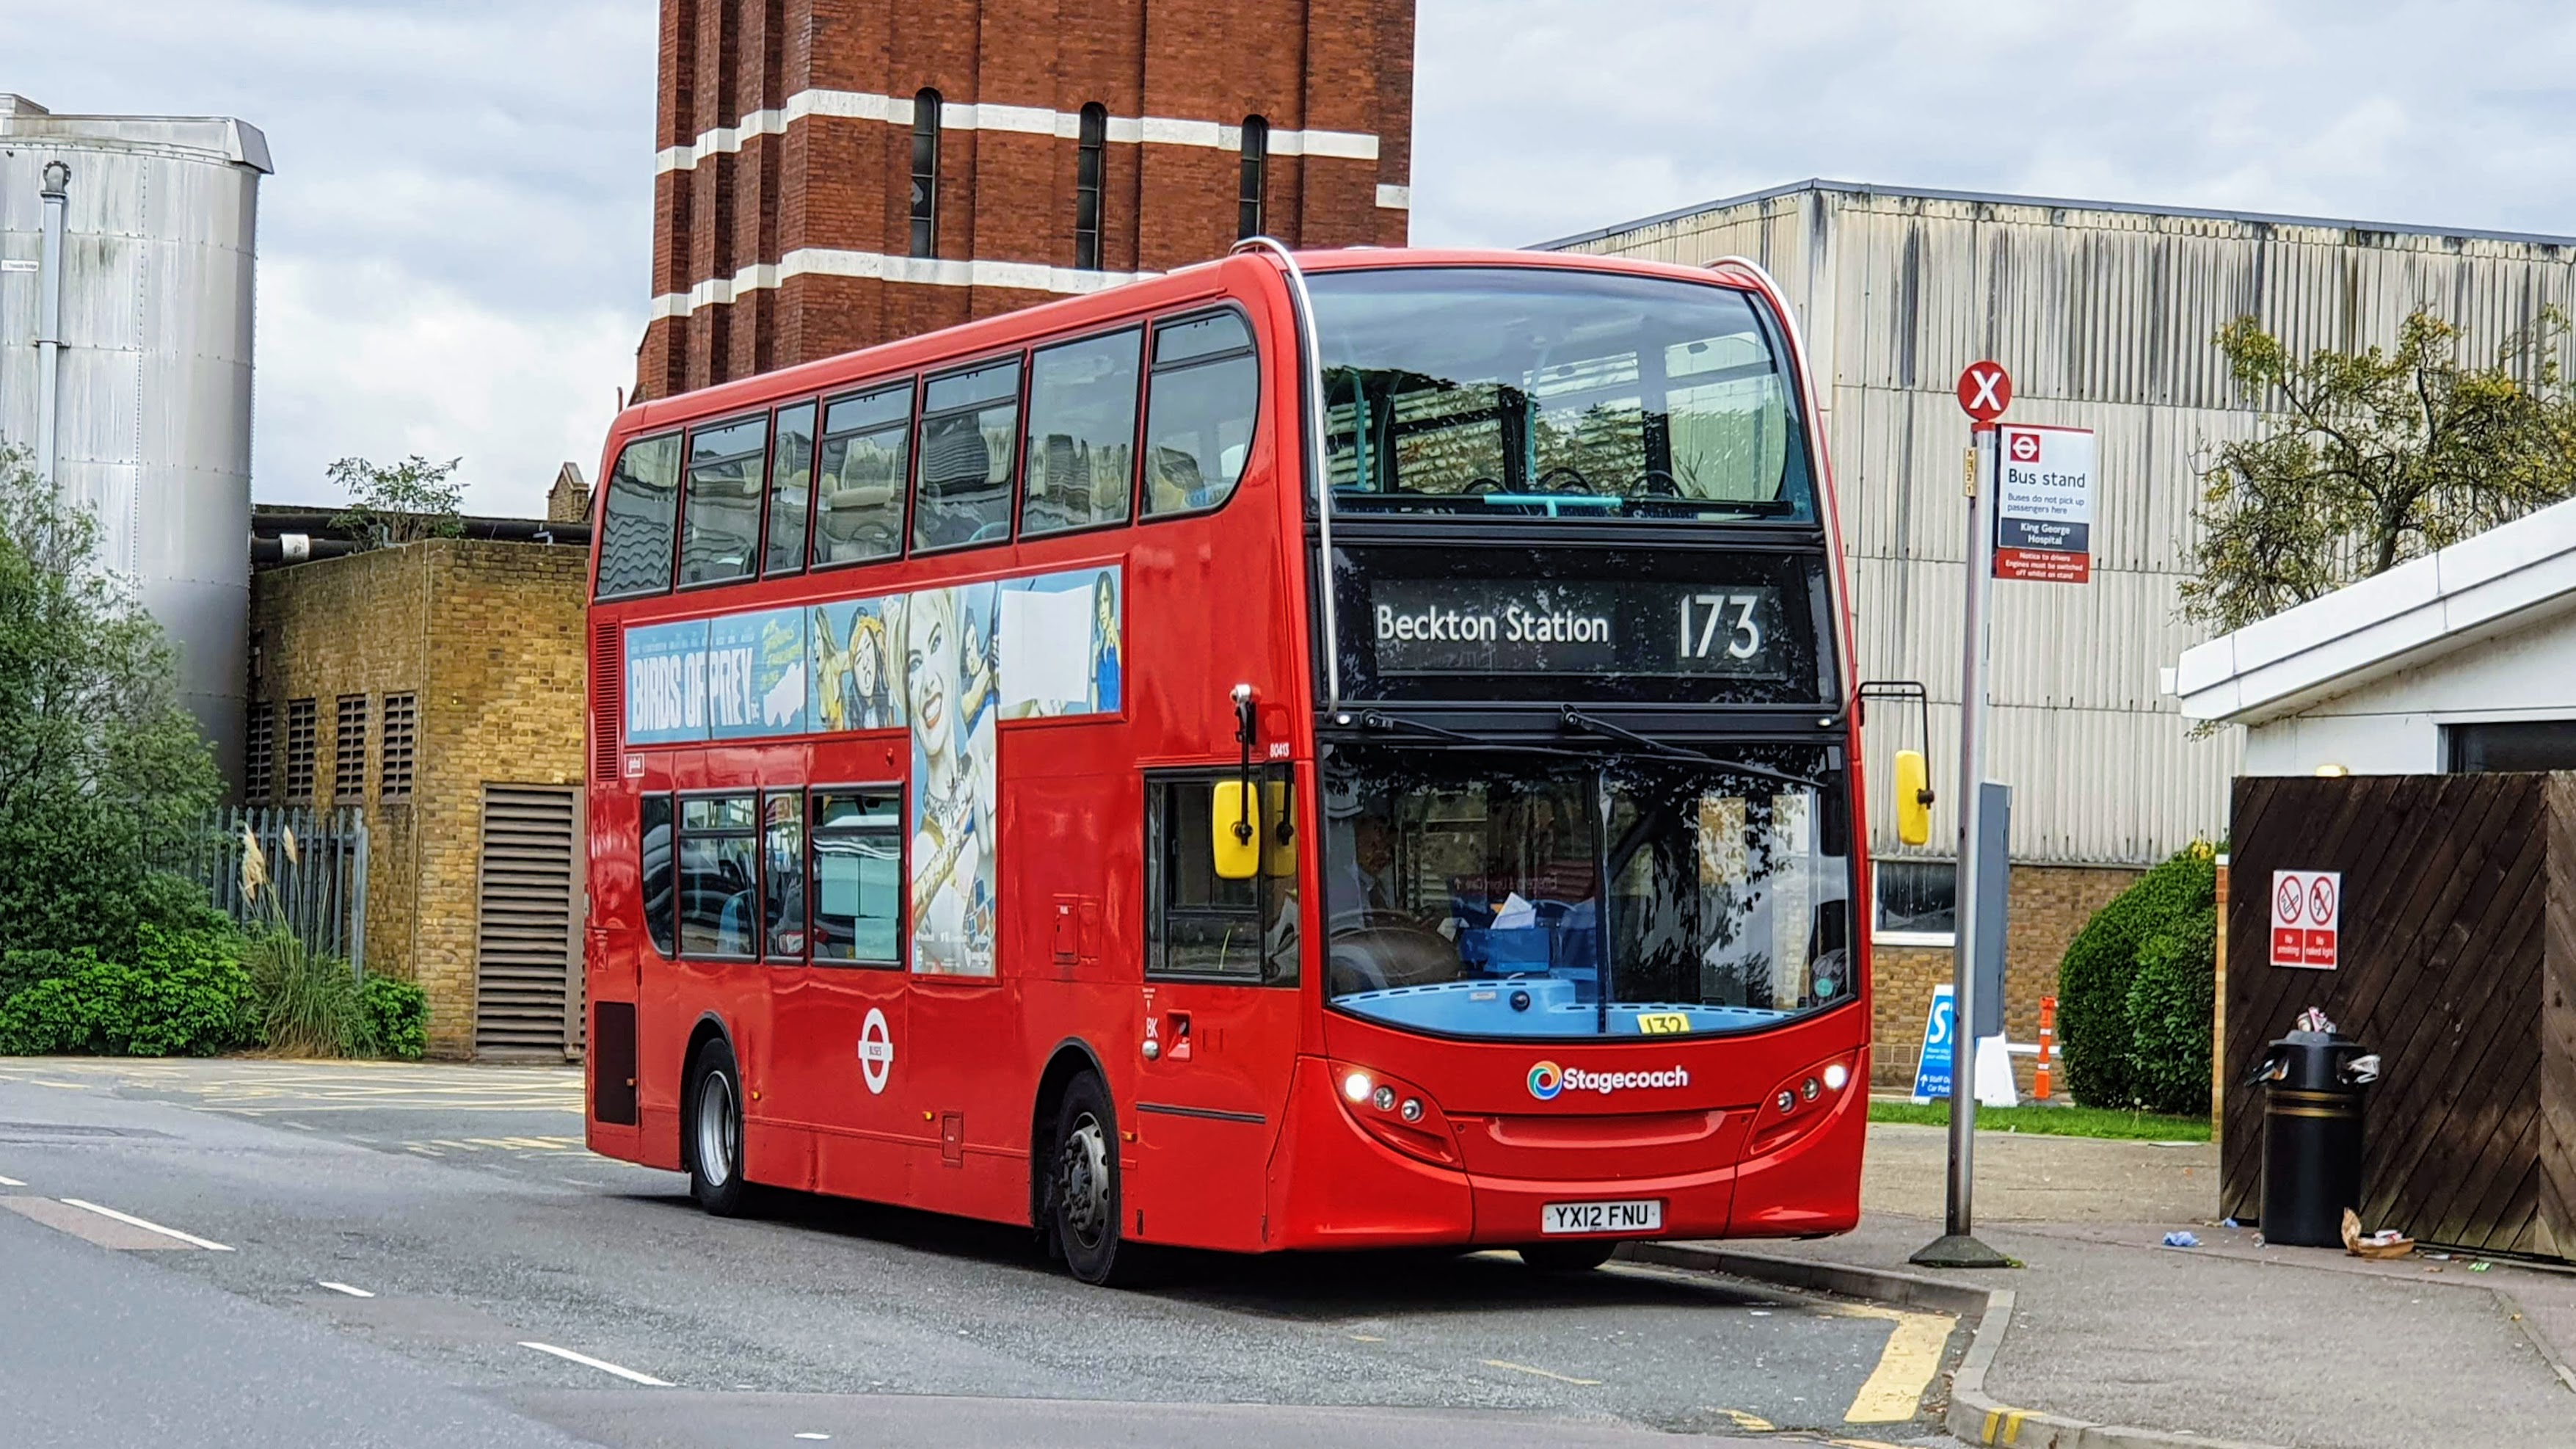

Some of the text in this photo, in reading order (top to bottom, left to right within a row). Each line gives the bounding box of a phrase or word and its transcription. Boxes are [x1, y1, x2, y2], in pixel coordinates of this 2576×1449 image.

[1969, 370, 2001, 411] X
[2009, 468, 2086, 488] Bus stand
[2007, 493, 2030, 501] Buses
[2032, 495, 2042, 503] do
[2059, 497, 2073, 505] pick
[2007, 504, 2049, 514] passengers
[2020, 522, 2070, 536] King George
[2028, 534, 2062, 545] Hospital
[1377, 594, 1760, 659] Beckton Station 173
[631, 654, 681, 732] BIRDS
[684, 651, 706, 728] OF
[709, 647, 754, 727] PREY
[1562, 1065, 1688, 1094] Stagecoach
[1556, 1205, 1648, 1228] YX12 FNU
